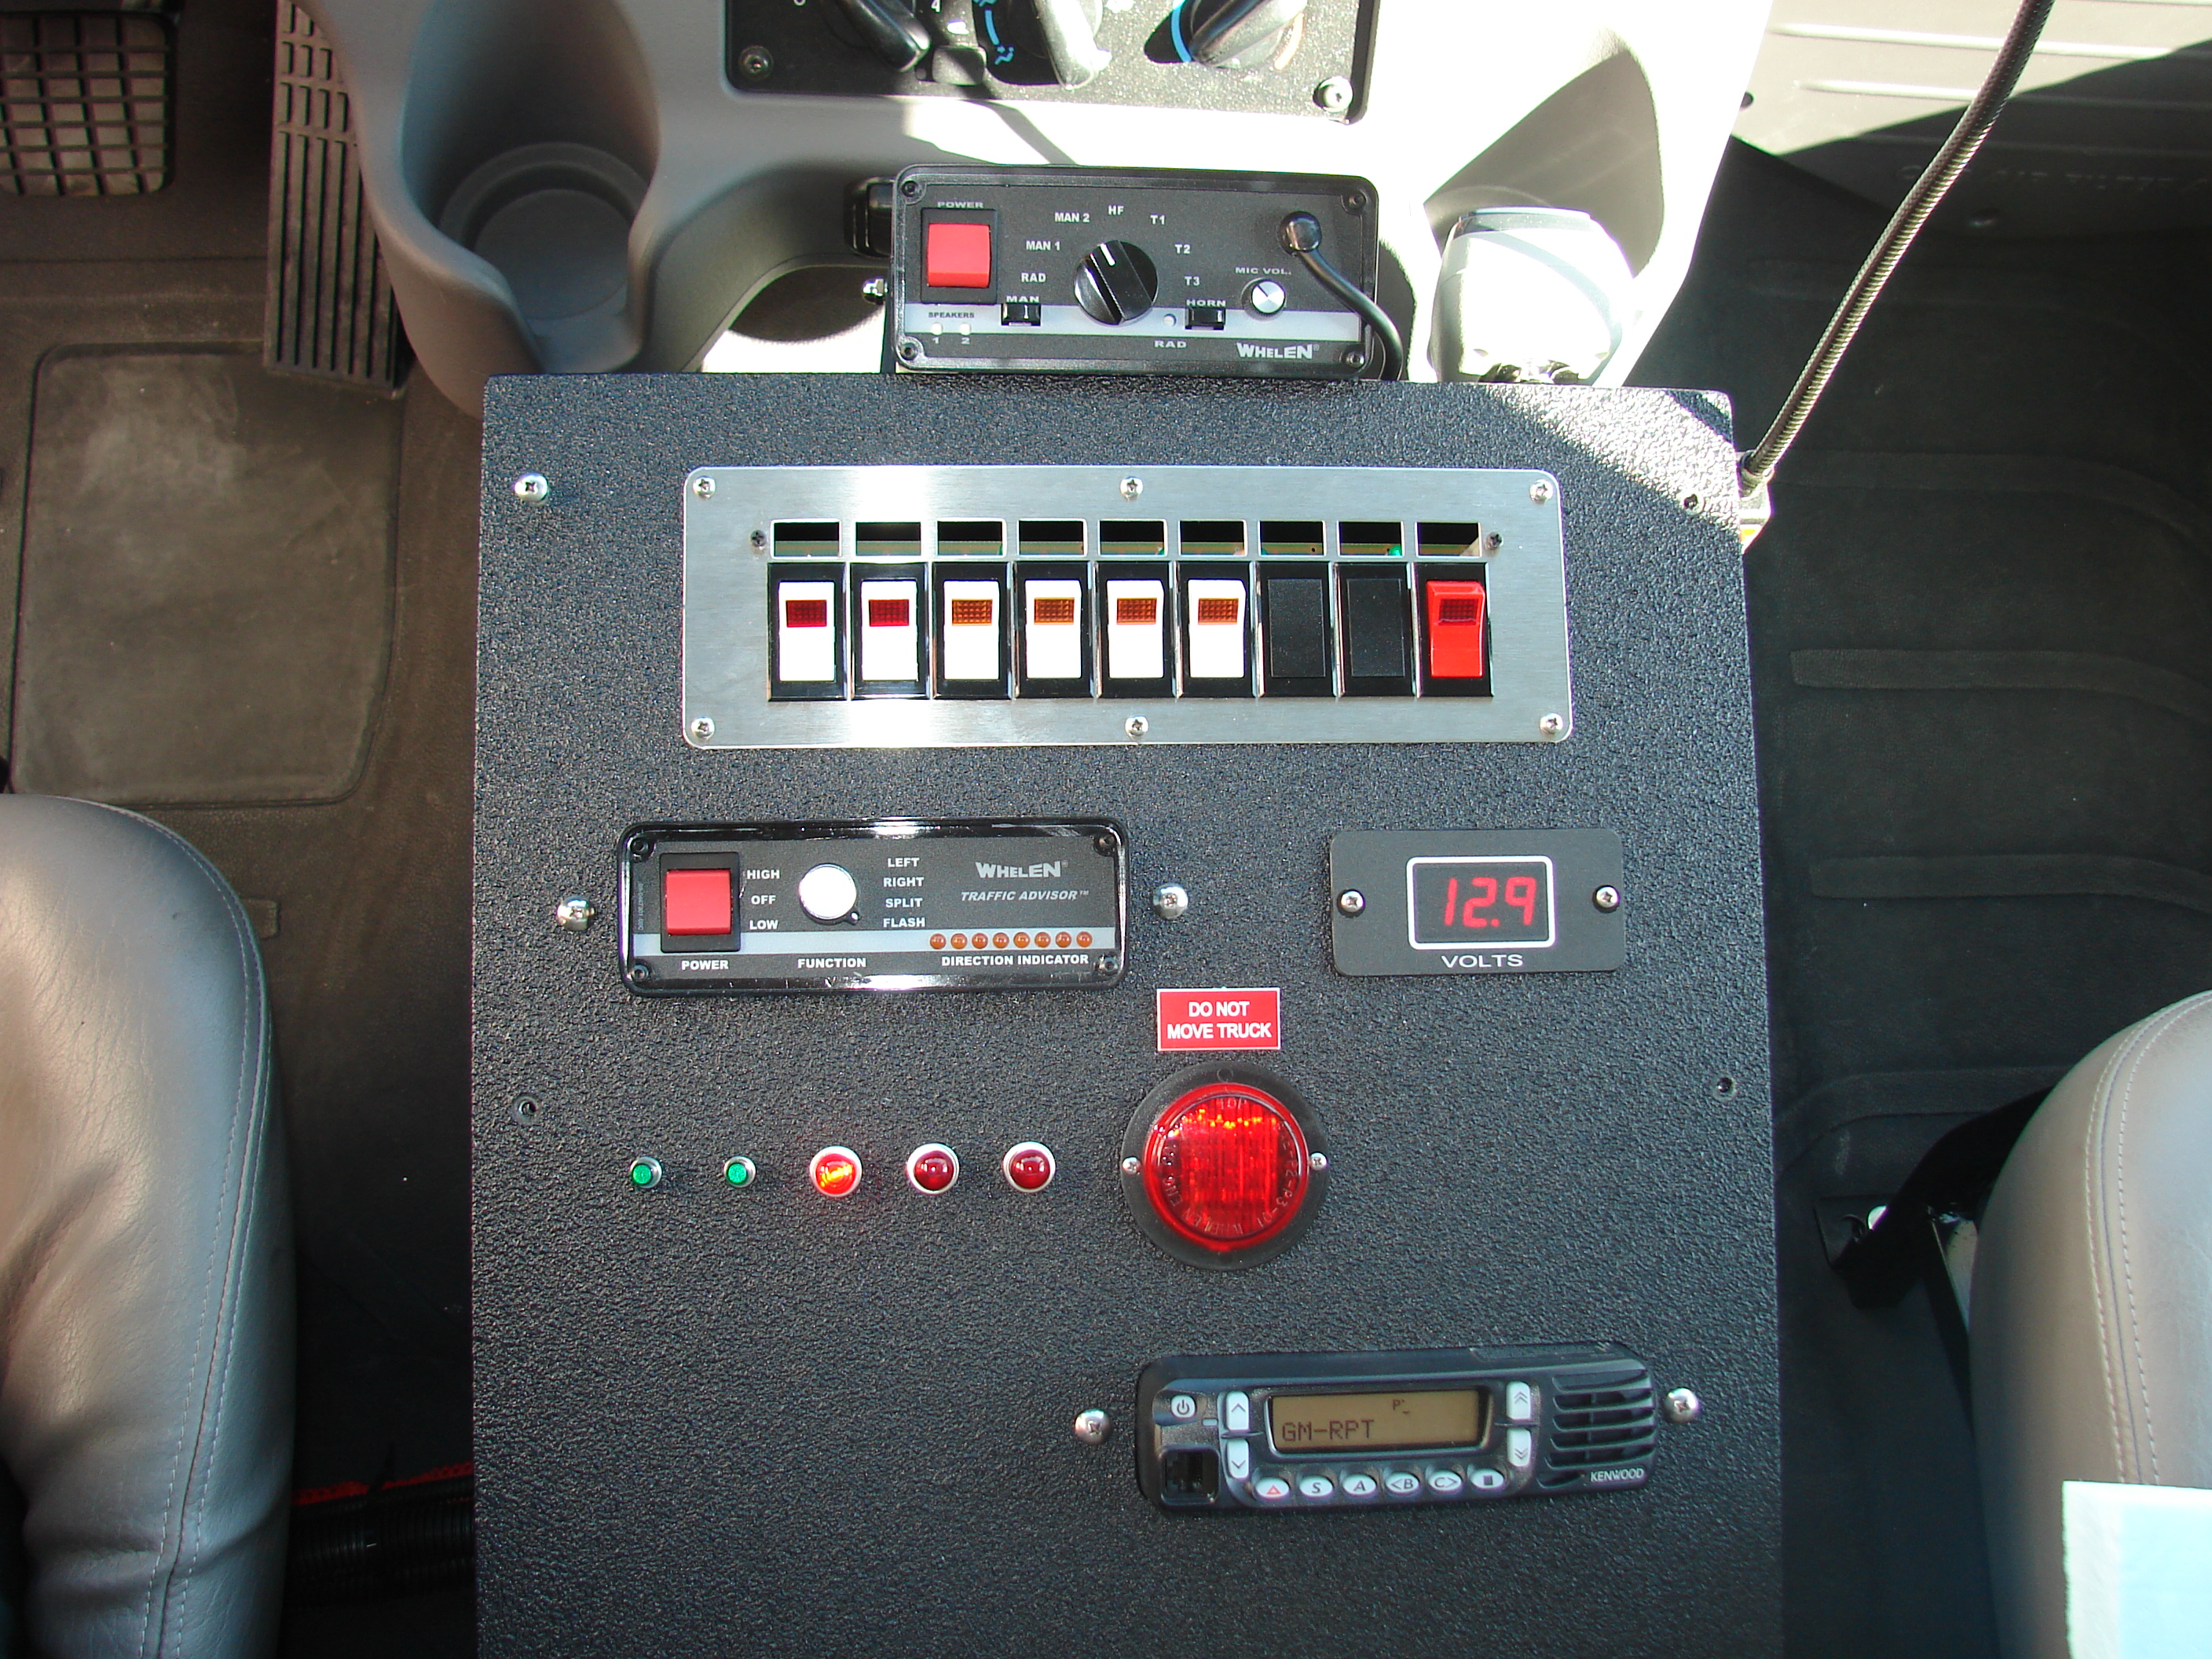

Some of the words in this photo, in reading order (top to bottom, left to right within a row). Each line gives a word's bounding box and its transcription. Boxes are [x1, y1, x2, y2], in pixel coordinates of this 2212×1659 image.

[1108, 205, 1124, 216] HF
[1054, 212, 1079, 222] MAN
[1082, 213, 1090, 222] 2
[1150, 214, 1166, 225] T1
[1026, 240, 1052, 251] MAN
[1054, 241, 1061, 251] 1
[1174, 244, 1191, 255] T2
[1021, 273, 1046, 283] RAD
[1185, 276, 1200, 286] T3
[1006, 295, 1040, 303] MAN
[888, 857, 920, 867] LEFT
[746, 870, 781, 880] HIGH
[883, 877, 925, 887] RIGHT
[751, 895, 777, 905] OFF
[961, 891, 1016, 901] TRAFFIC
[884, 898, 923, 908] SPLIT
[1444, 876, 1537, 928] 12.9
[749, 920, 778, 930] LOW
[883, 917, 926, 928] FLASH
[681, 960, 729, 970] POWER
[797, 958, 867, 969] FUNCTION
[942, 955, 1014, 966] DIRECTION
[1017, 954, 1090, 965] INDICATOR
[1441, 954, 1524, 969] VOLTS
[1188, 1002, 1214, 1017] DO
[1216, 1001, 1251, 1016] NOT
[1166, 1024, 1214, 1039] MOVE
[1216, 1022, 1273, 1038] TRUCK
[1281, 1419, 1375, 1441] GM-RPT
[1590, 1468, 1646, 1483] KENWOOD
[1311, 1481, 1322, 1494] S
[1353, 1480, 1367, 1492] A
